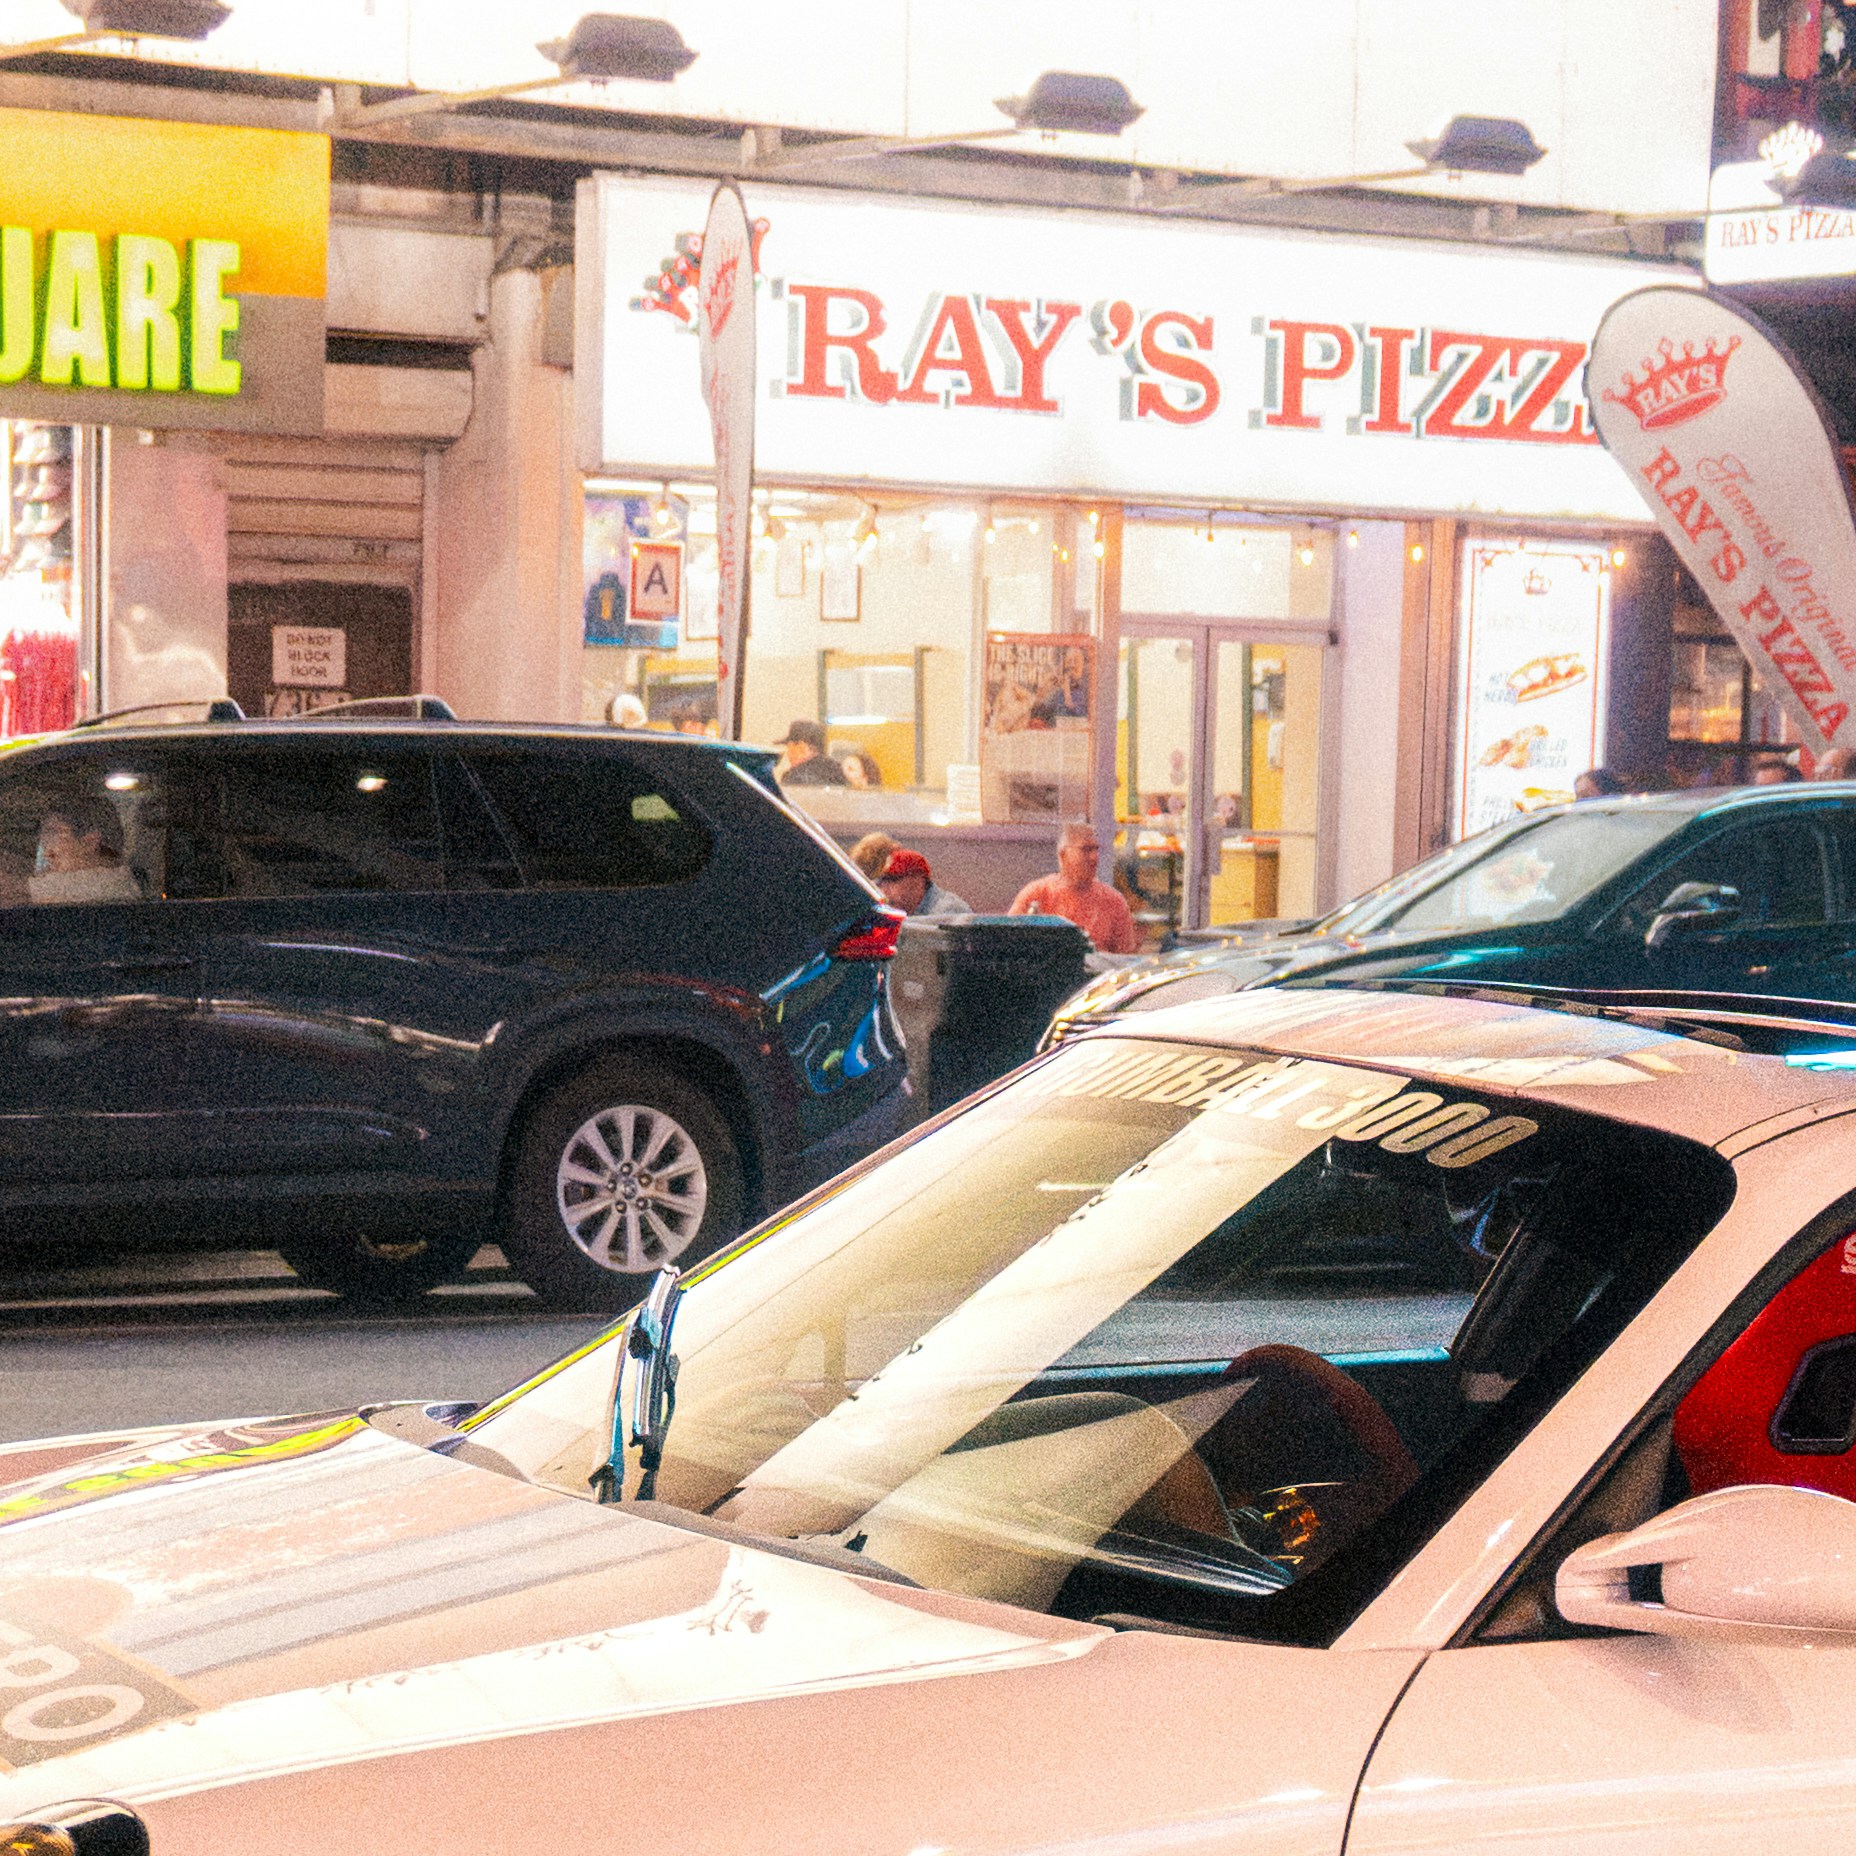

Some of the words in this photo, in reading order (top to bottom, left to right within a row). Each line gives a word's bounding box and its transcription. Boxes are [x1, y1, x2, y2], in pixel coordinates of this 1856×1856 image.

[1720, 218, 1782, 248] RAY'S
[1788, 208, 1856, 244] PIZZA
[786, 284, 1222, 428] RAY'S
[1264, 319, 1601, 447] PIZZ
[1635, 361, 1719, 414] RAY'S
[1695, 453, 1781, 564] Famous
[643, 561, 669, 596] A
[1641, 444, 1746, 584] RAY'S
[1739, 587, 1848, 745] PIZZA
[287, 649, 332, 663] BLOCK
[1296, 1079, 1540, 1169] 3000
